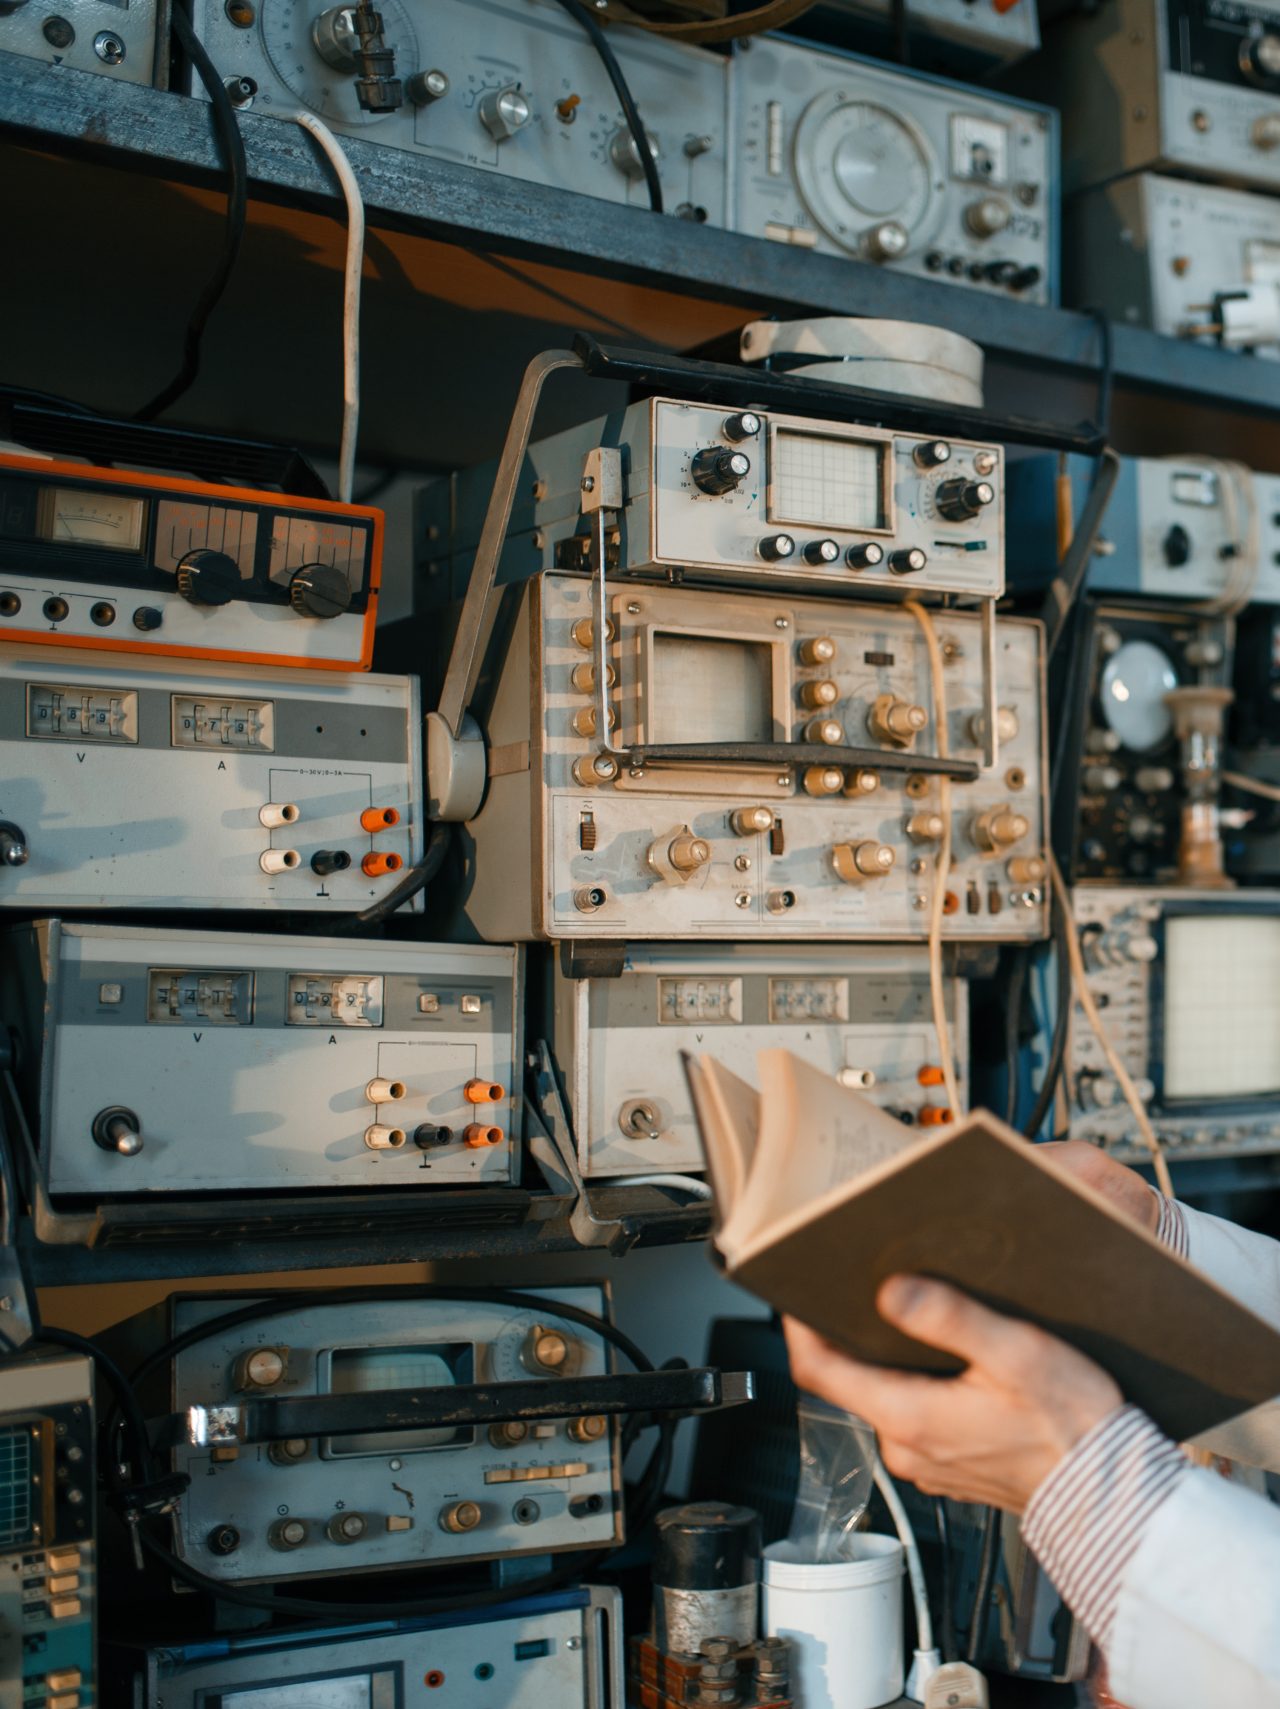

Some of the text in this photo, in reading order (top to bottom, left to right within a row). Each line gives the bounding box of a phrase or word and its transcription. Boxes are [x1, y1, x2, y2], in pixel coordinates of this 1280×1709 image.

[76, 752, 86, 763] V
[217, 760, 226, 771] A
[193, 1032, 203, 1043] V
[328, 1034, 337, 1045] A
[695, 1032, 704, 1043] V
